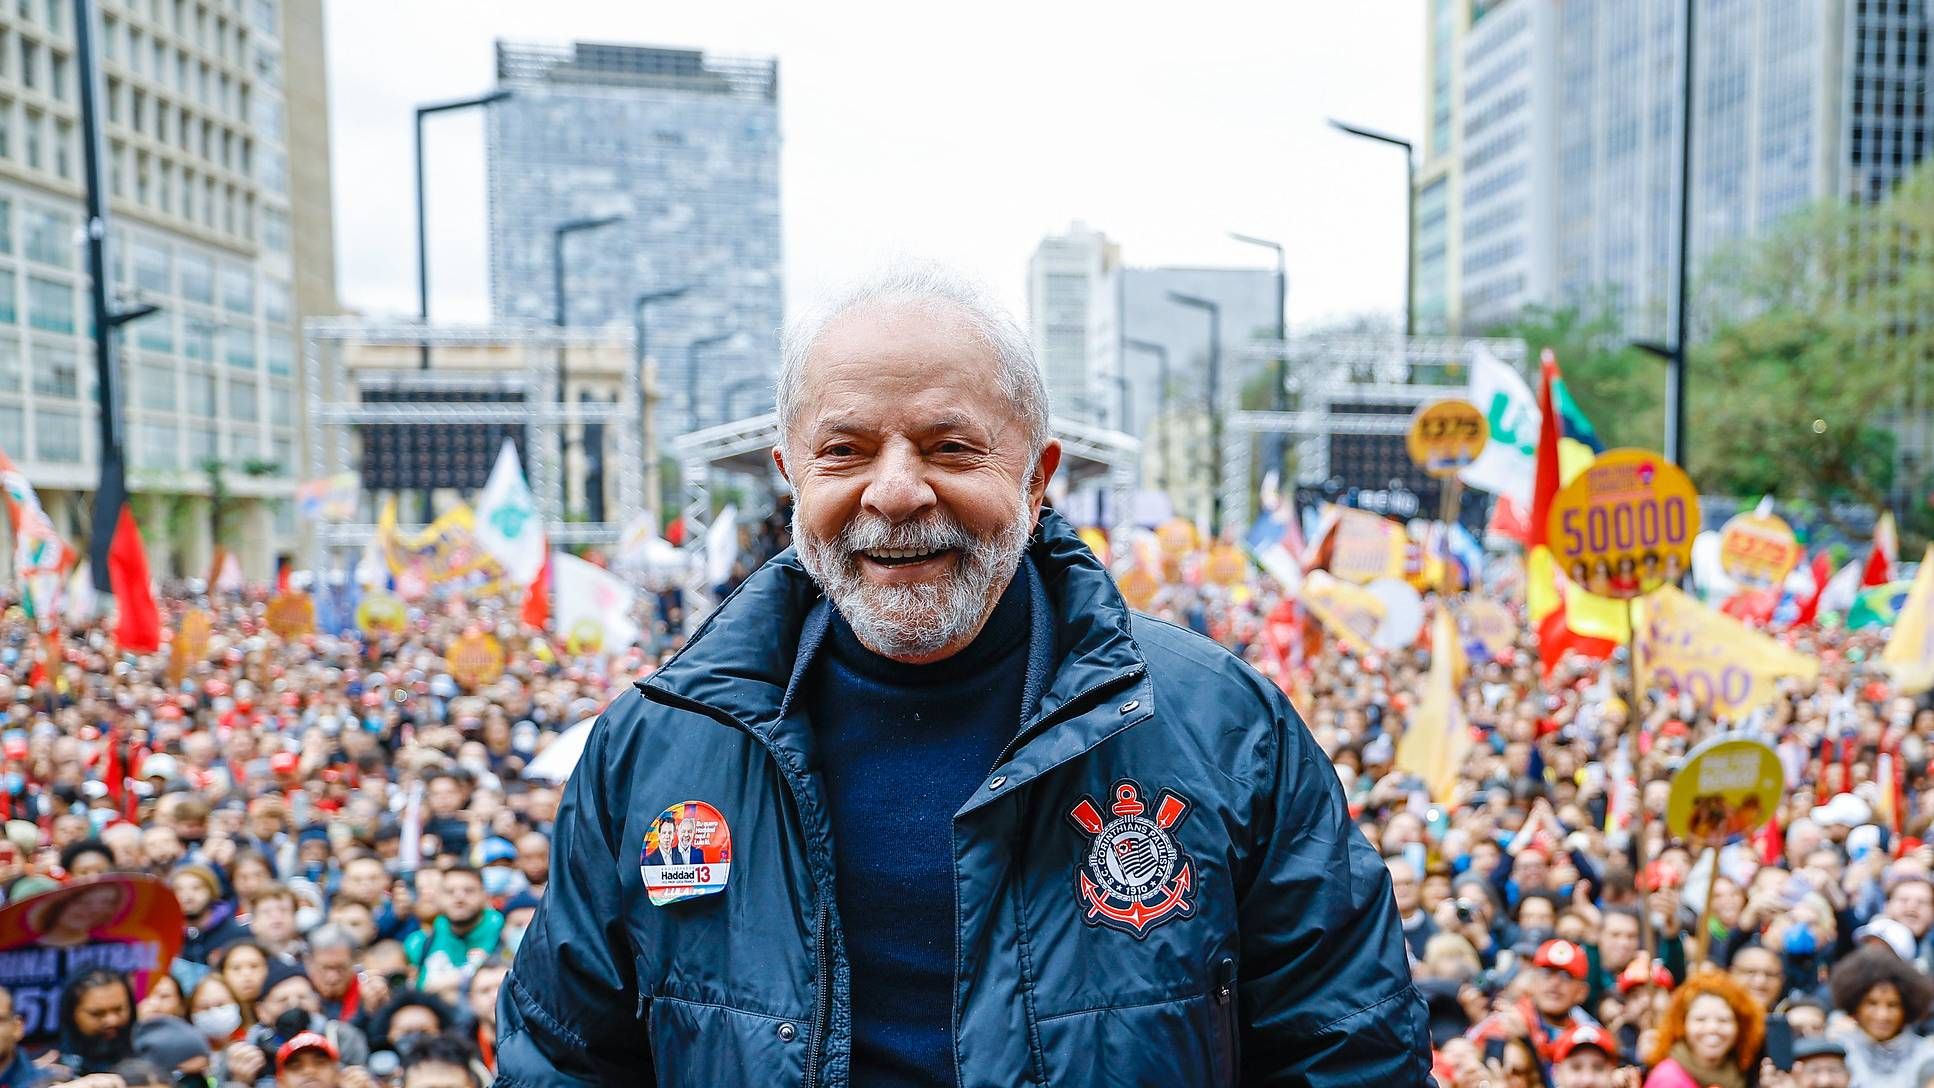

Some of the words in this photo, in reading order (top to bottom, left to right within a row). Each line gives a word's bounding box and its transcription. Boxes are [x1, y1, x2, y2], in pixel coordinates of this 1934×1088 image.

[1563, 497, 1687, 557] 50000
[1098, 823, 1148, 865] CORINTHIANS
[1148, 831, 1168, 877] PAULISTA
[661, 870, 695, 881] Haddad
[694, 866, 711, 883] 13
[1126, 886, 1148, 895] 1910
